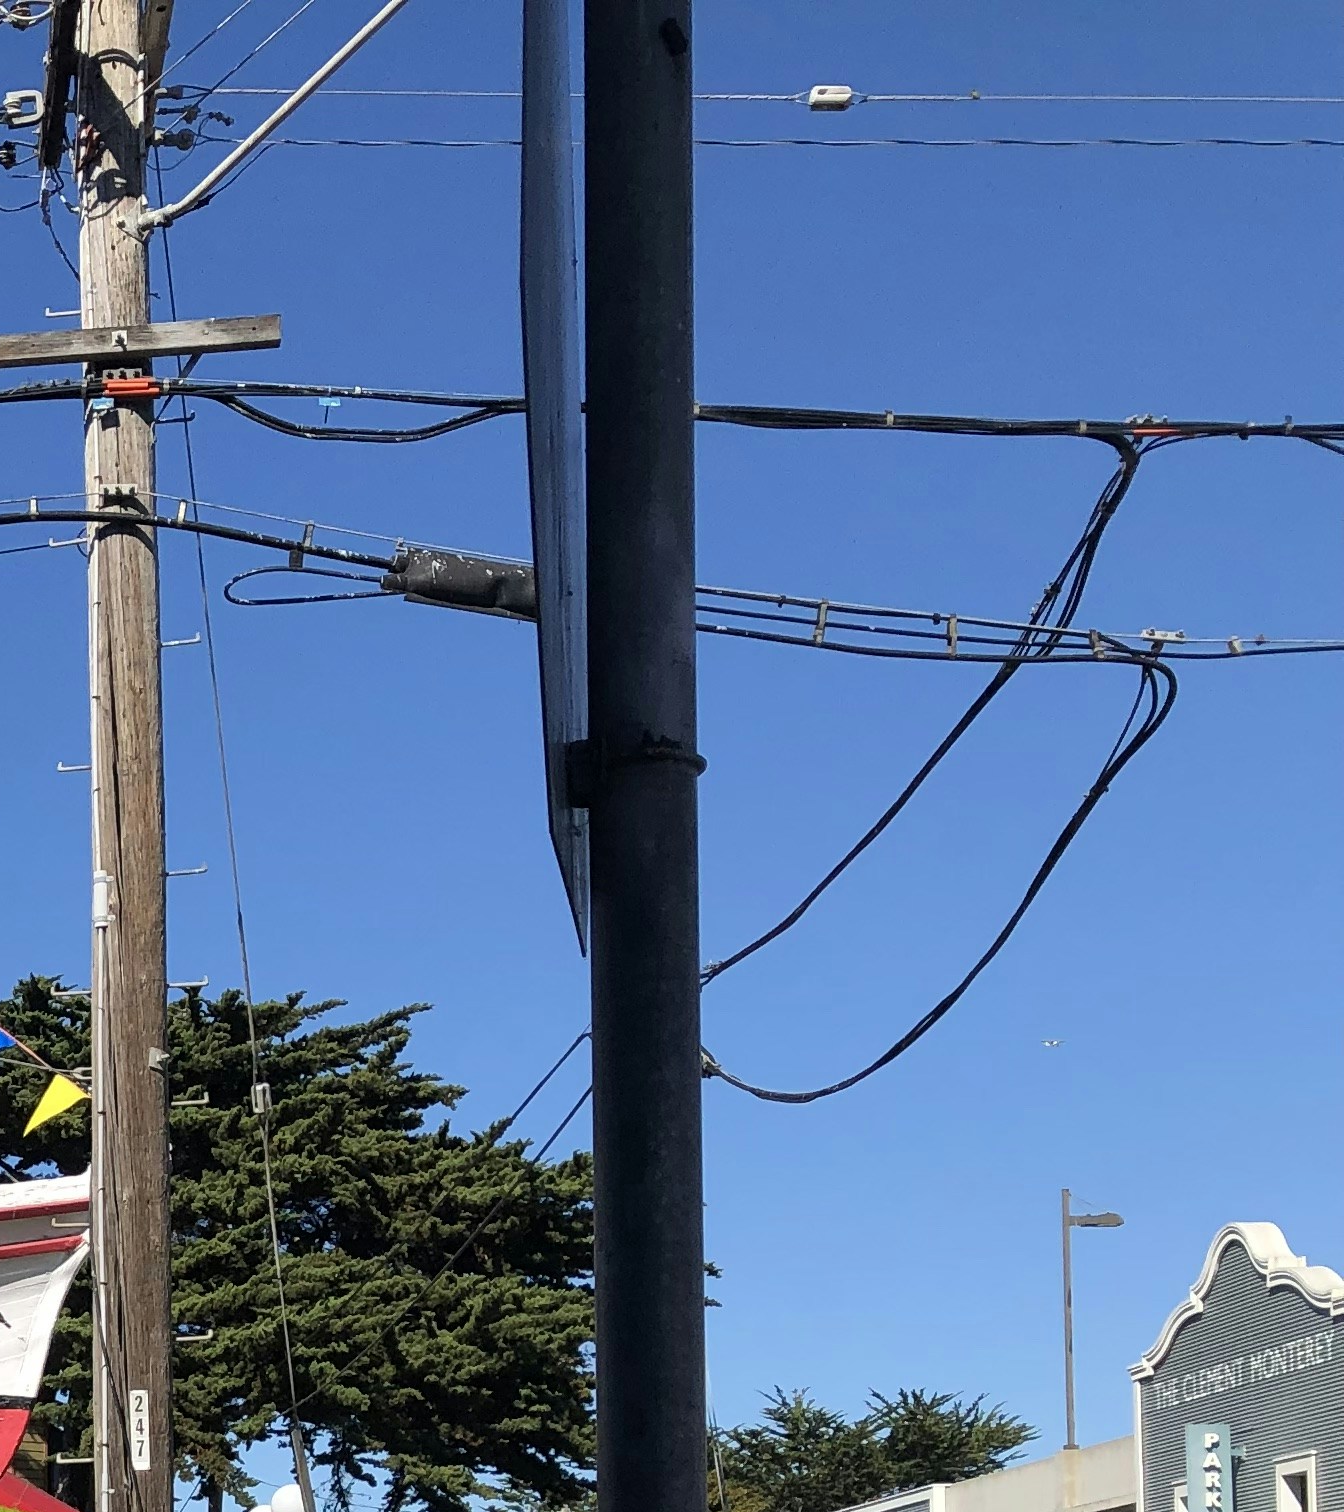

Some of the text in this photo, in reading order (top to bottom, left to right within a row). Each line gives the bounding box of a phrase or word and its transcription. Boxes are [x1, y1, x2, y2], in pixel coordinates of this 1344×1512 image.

[1154, 1329, 1335, 1409] THE CLEMENT MONTEREY
[134, 1395, 146, 1458] 247
